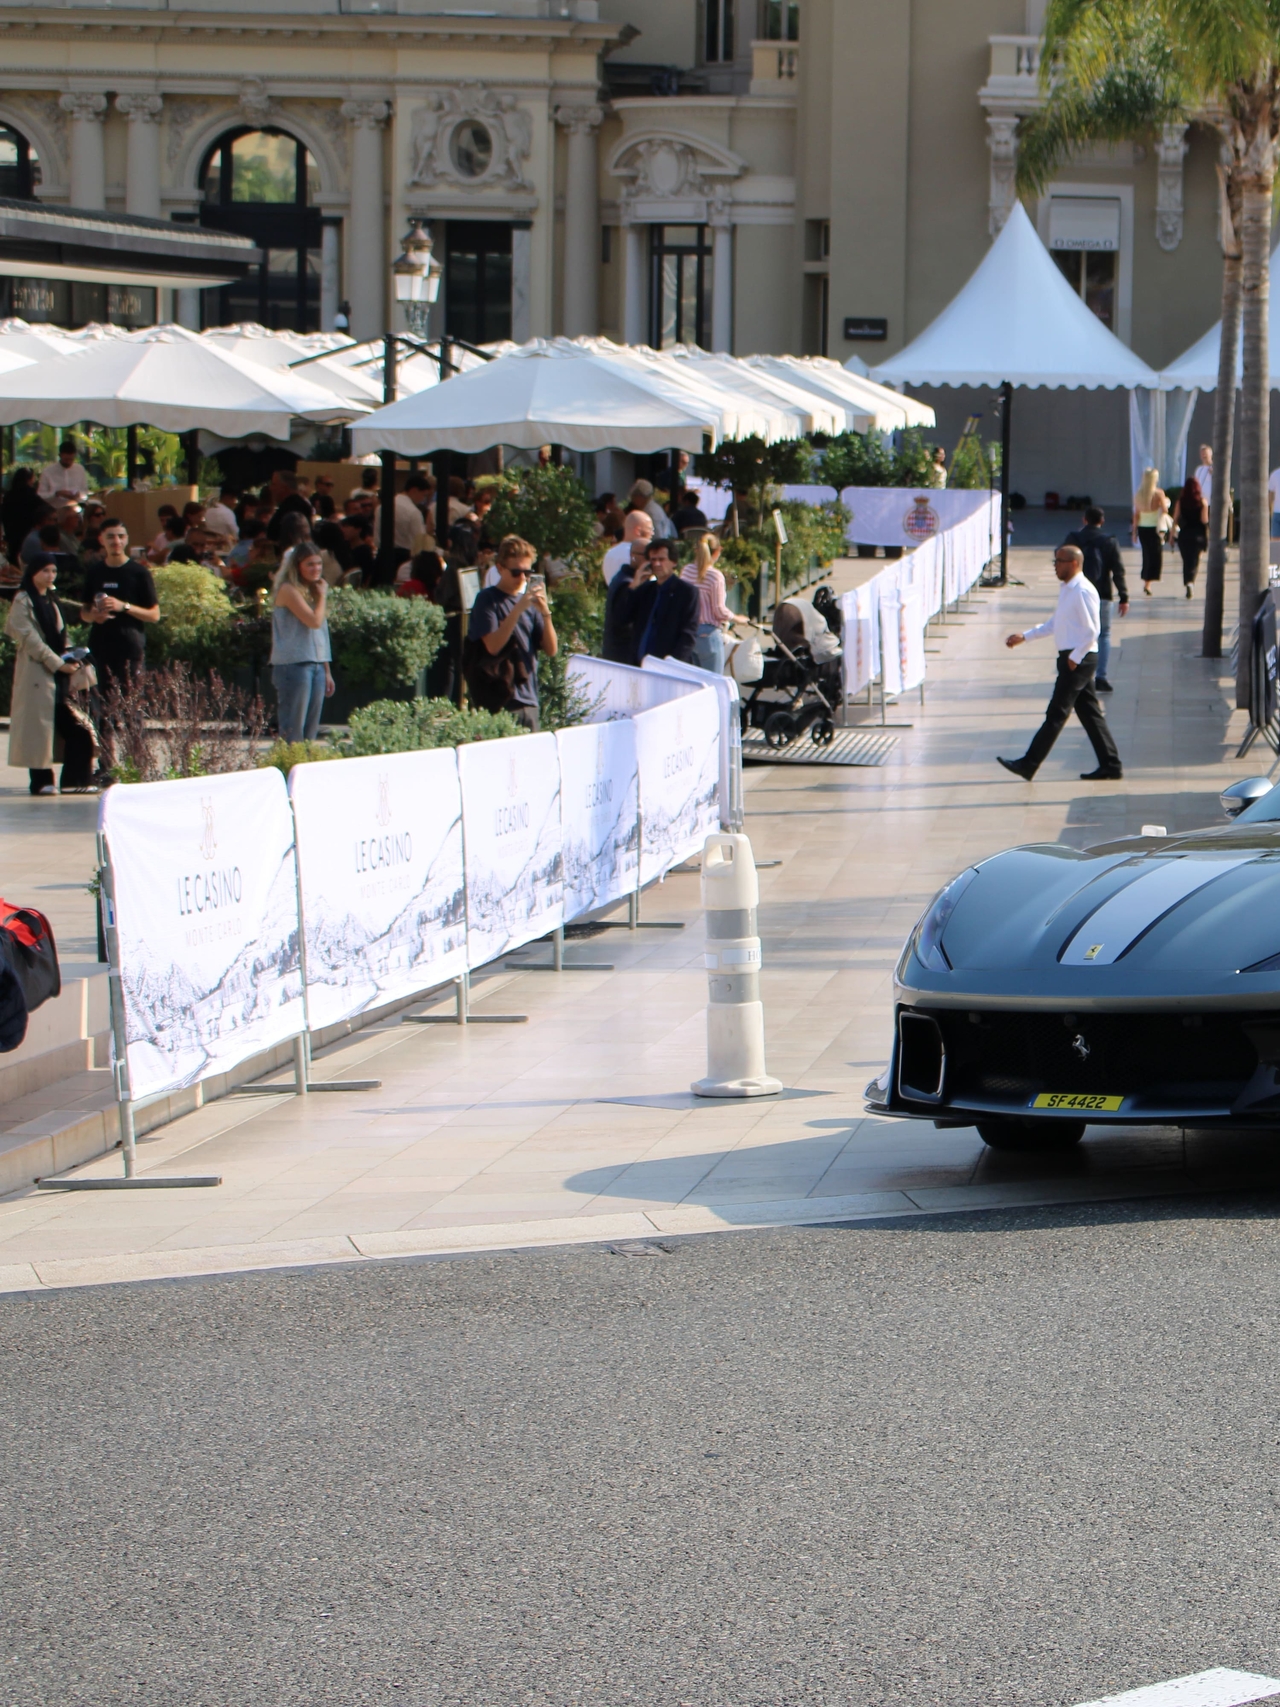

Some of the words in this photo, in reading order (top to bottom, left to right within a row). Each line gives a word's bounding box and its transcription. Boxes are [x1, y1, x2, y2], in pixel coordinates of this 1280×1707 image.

[1066, 239, 1101, 248] OMEGA
[370, 831, 412, 870] CASINO
[195, 865, 242, 913] CASINO
